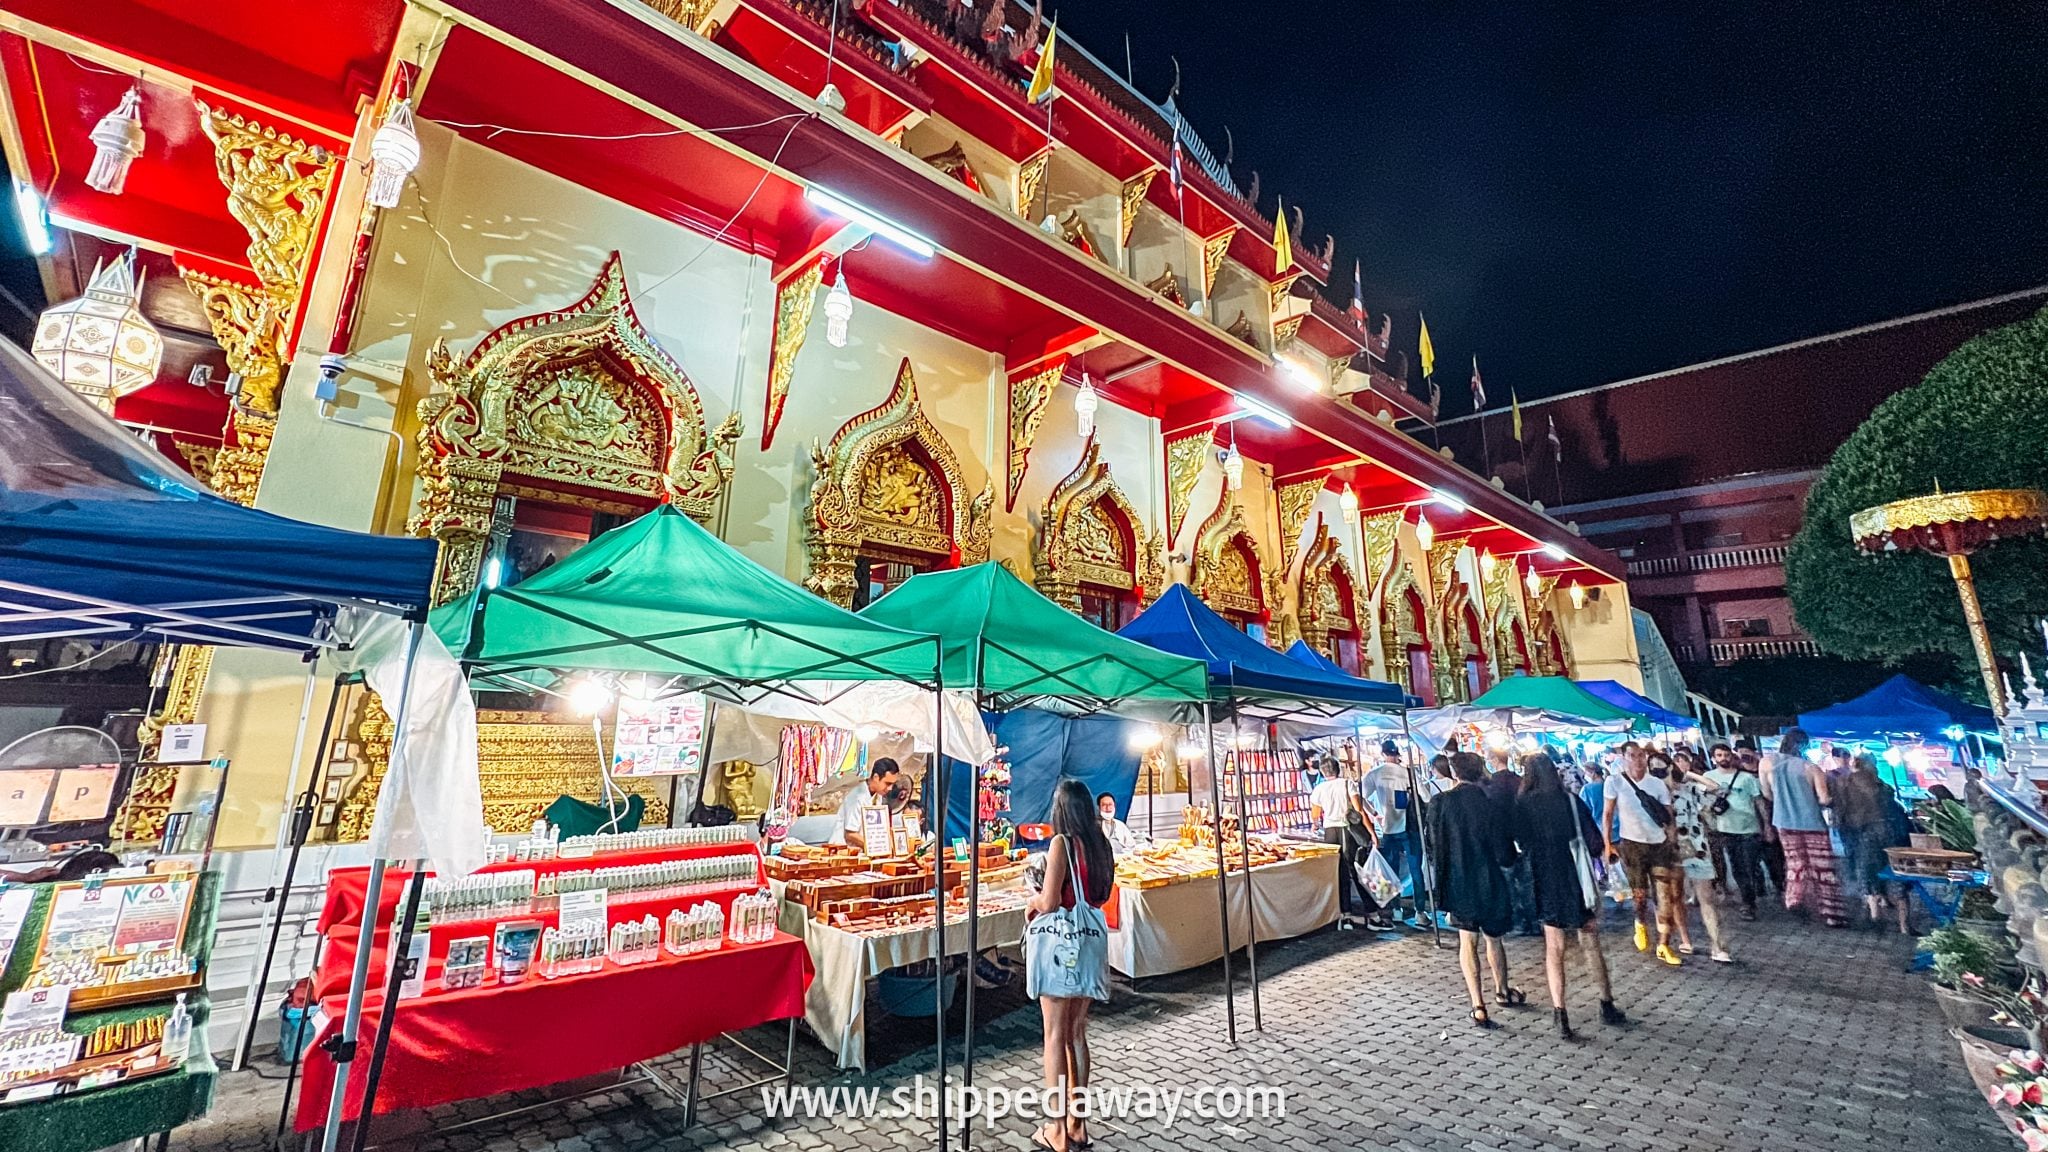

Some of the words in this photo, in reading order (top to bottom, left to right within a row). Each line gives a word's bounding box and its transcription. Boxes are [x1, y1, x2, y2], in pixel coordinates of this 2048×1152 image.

[11, 789, 25, 800] a
[74, 786, 90, 800] p
[1030, 926, 1061, 938] EACH
[1064, 927, 1100, 940] OTHER
